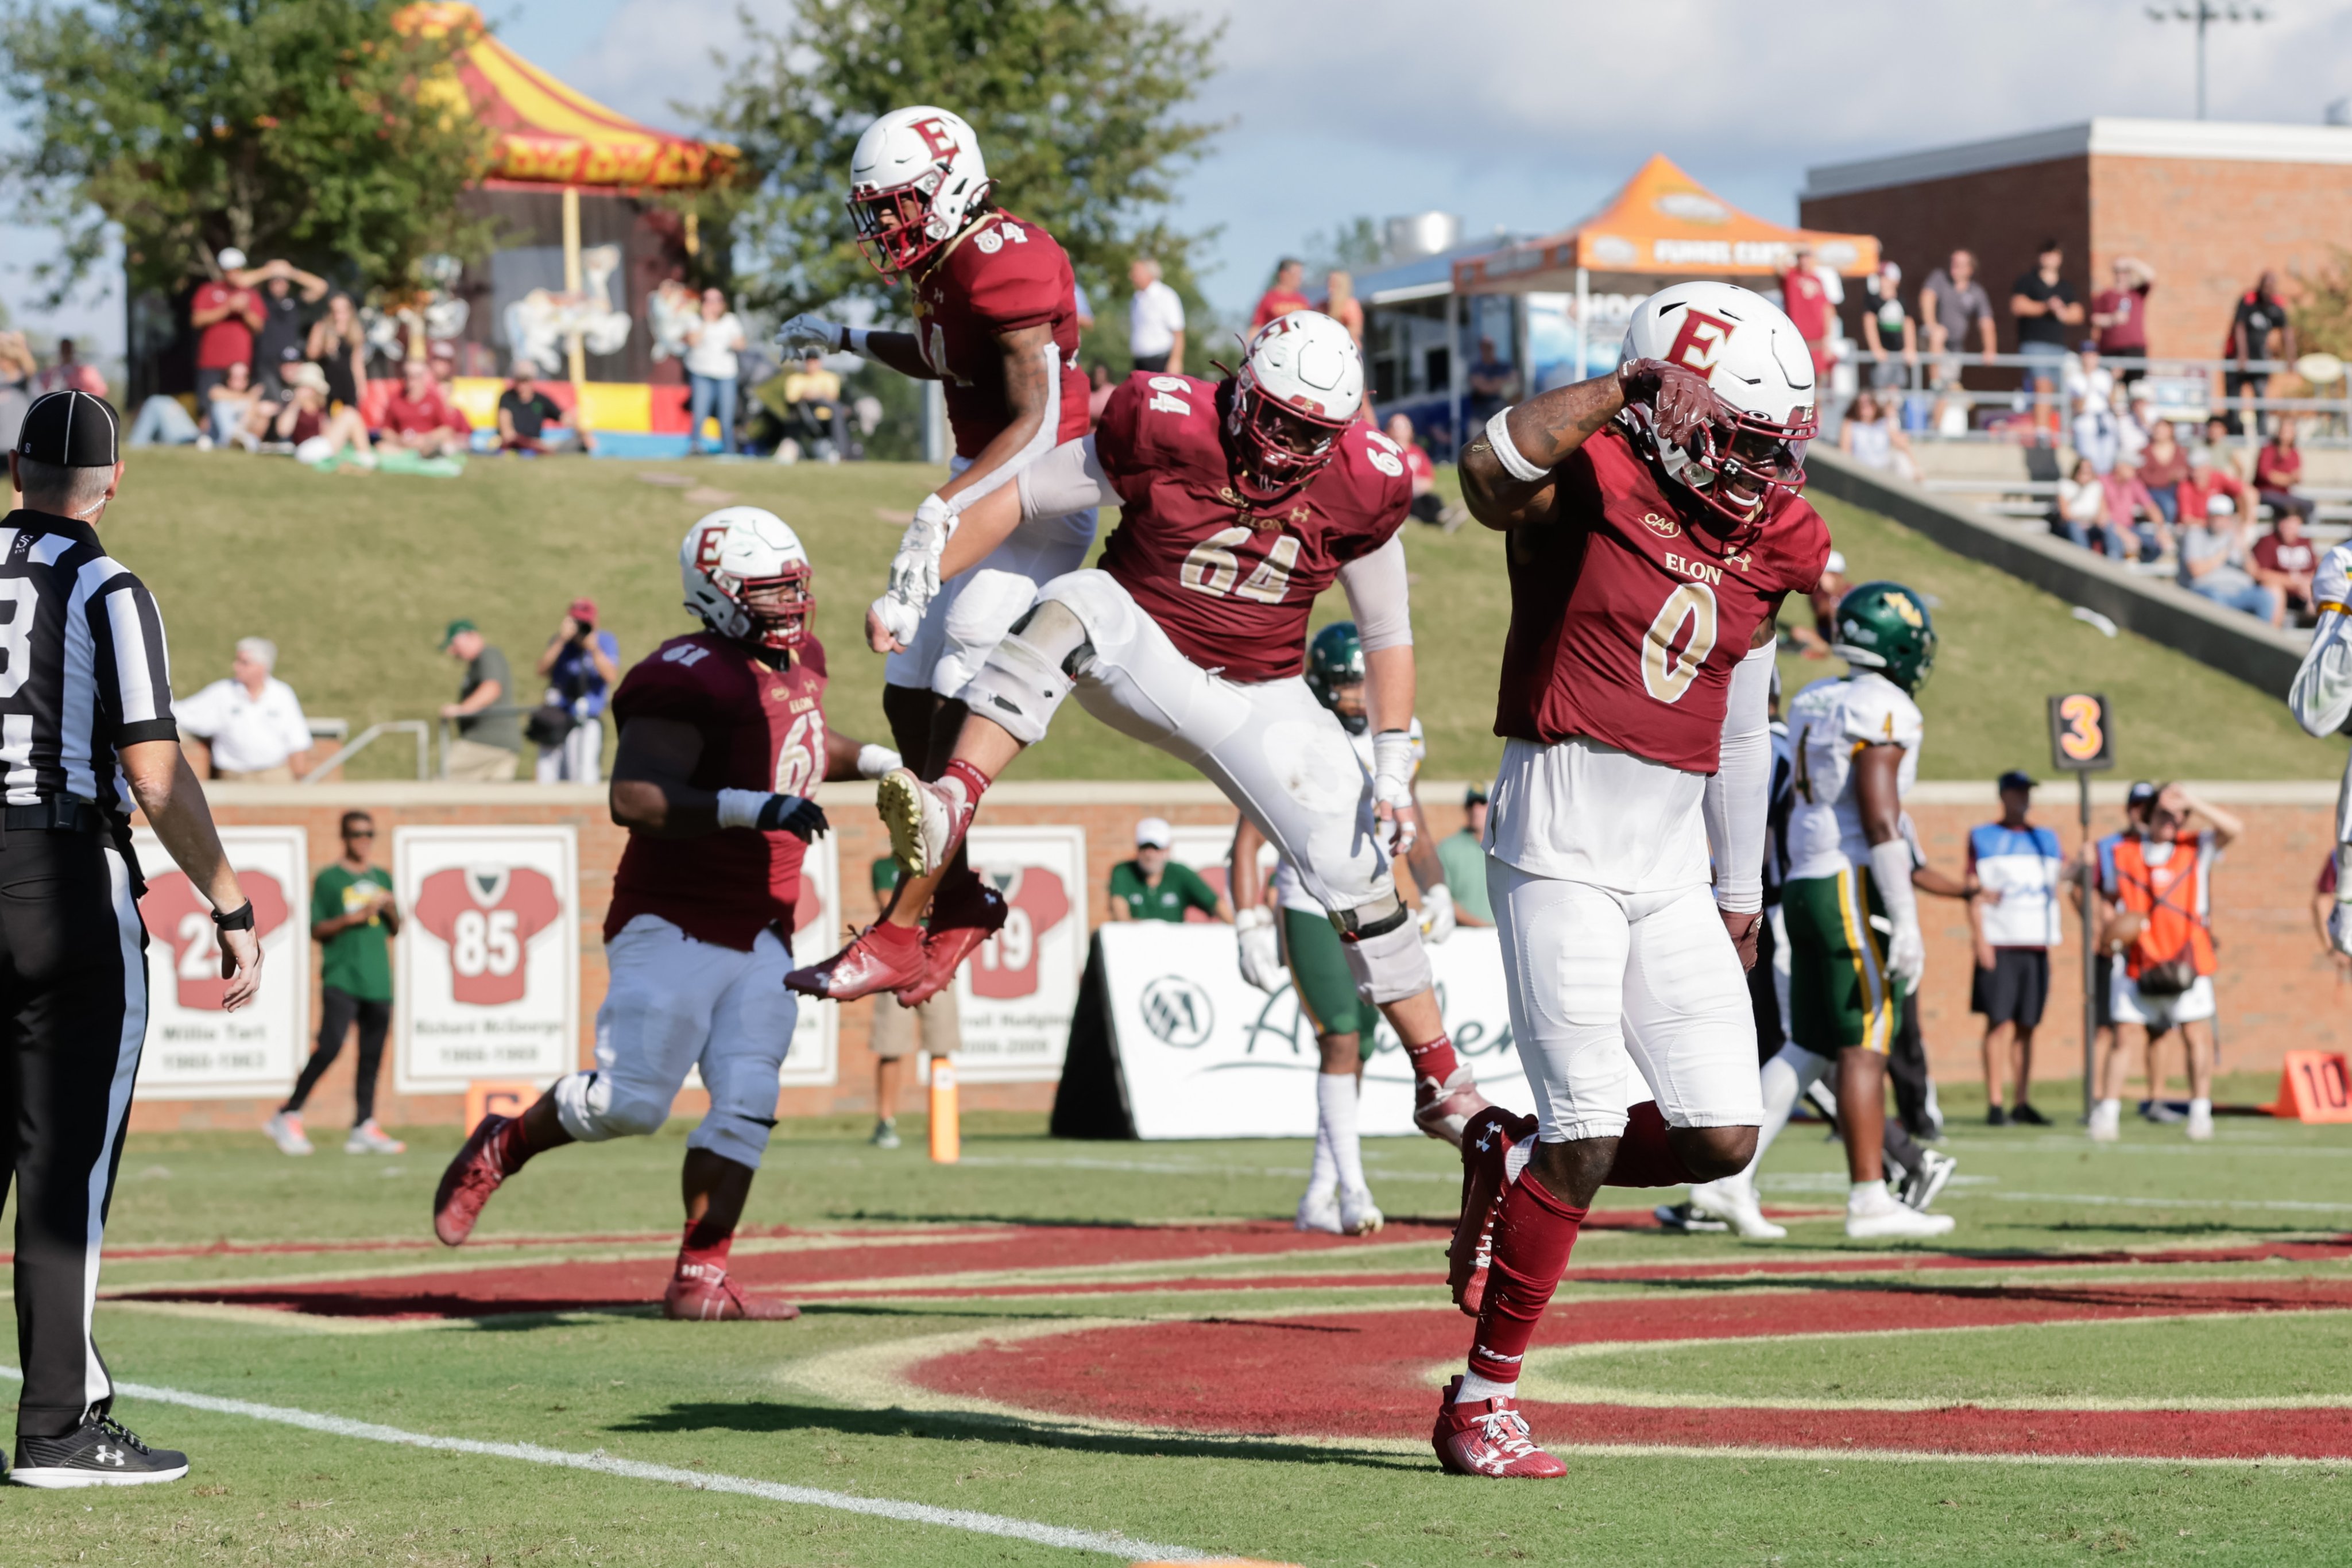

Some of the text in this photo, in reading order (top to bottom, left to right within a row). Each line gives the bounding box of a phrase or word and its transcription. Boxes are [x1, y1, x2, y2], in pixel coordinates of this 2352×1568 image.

[906, 117, 961, 163] E
[974, 221, 1028, 255] 84
[1662, 307, 1737, 383] E
[1148, 375, 1193, 416] 64
[1365, 429, 1404, 478] 64
[1237, 513, 1286, 532] ELON
[1644, 513, 1676, 534] CAA
[694, 526, 730, 567] E
[1180, 526, 1301, 605] 64
[1665, 551, 1723, 586] ELON
[662, 642, 711, 668] 61
[1641, 581, 1718, 704] 0
[1881, 711, 1894, 740] 4
[2060, 694, 2103, 761] 3
[775, 708, 825, 797] 61
[453, 909, 519, 977] 85
[2302, 1062, 2348, 1109] 10
